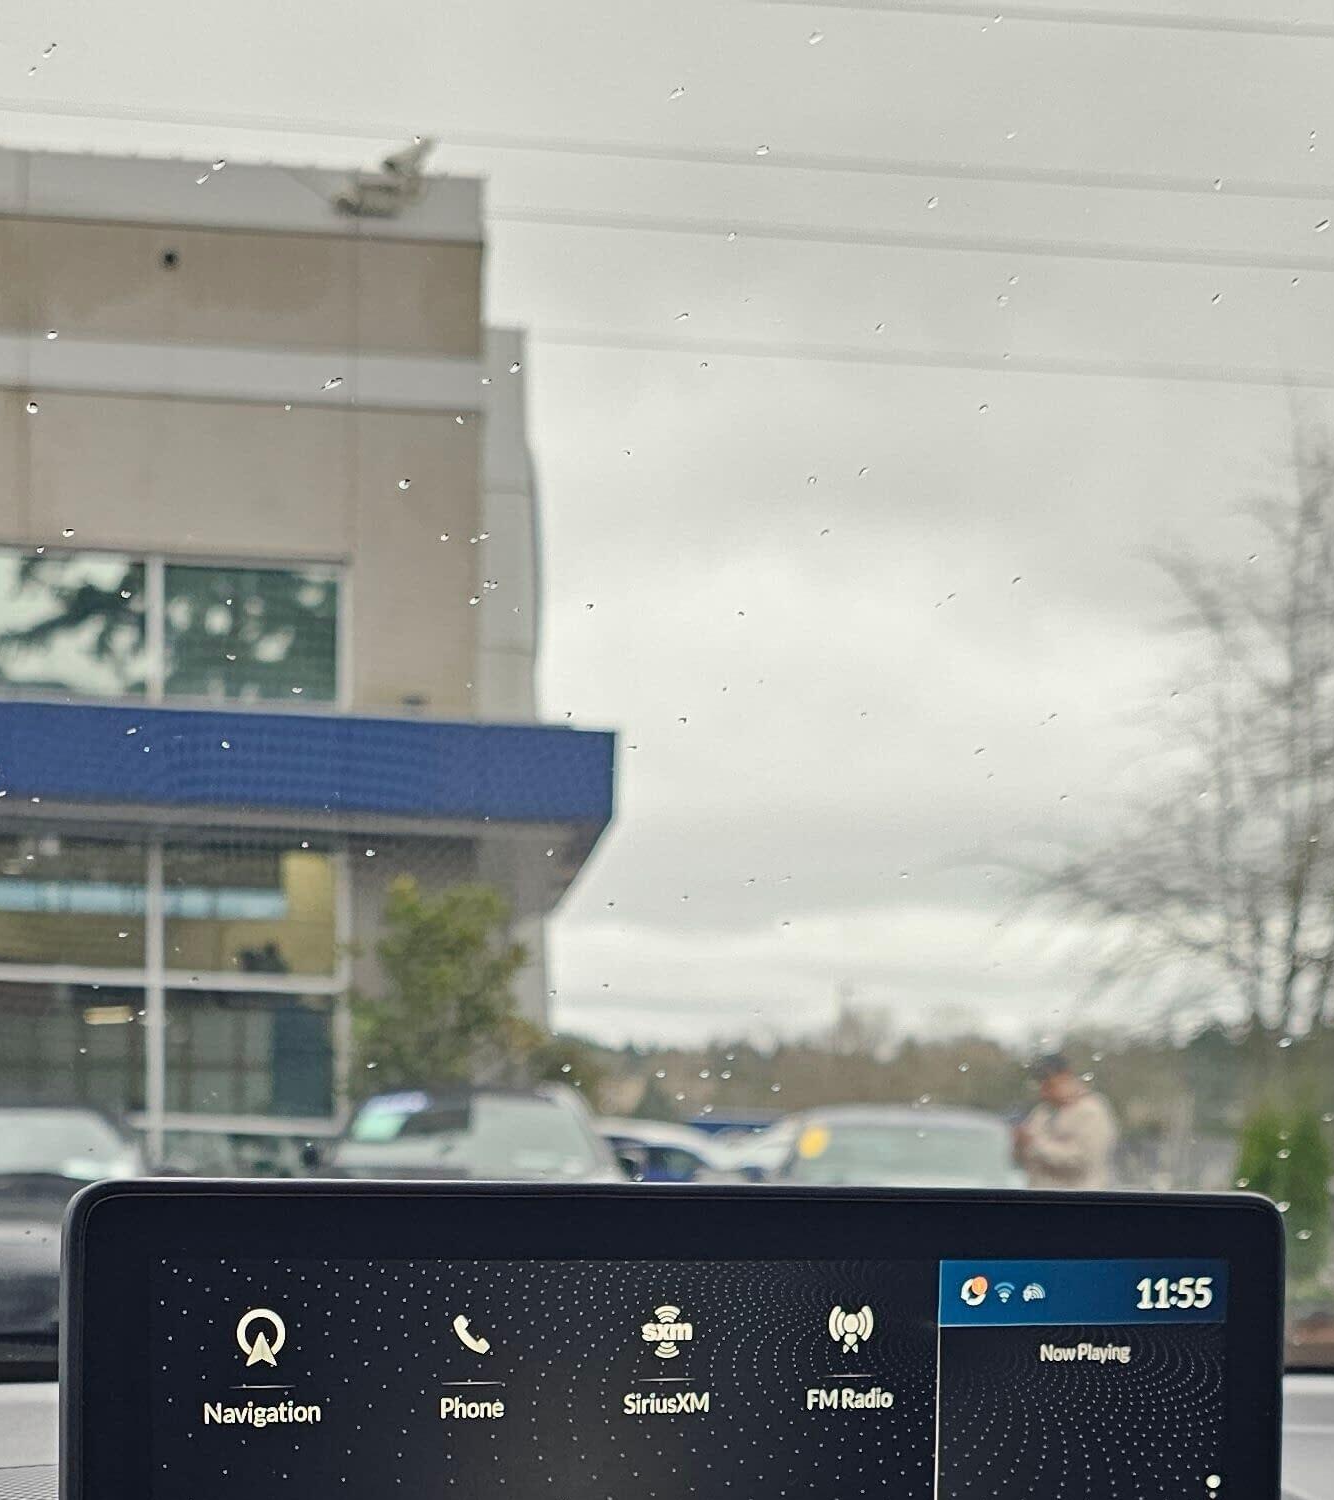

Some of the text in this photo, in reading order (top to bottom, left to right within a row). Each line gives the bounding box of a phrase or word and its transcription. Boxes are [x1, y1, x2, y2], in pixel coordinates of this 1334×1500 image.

[1137, 1277, 1213, 1310] 11:55
[1040, 1342, 1131, 1365] Now Playing
[440, 1396, 505, 1420] Phone
[623, 1391, 710, 1415] SiriusXM
[806, 1386, 894, 1411] FM Radio
[203, 1400, 322, 1428] Navigation
